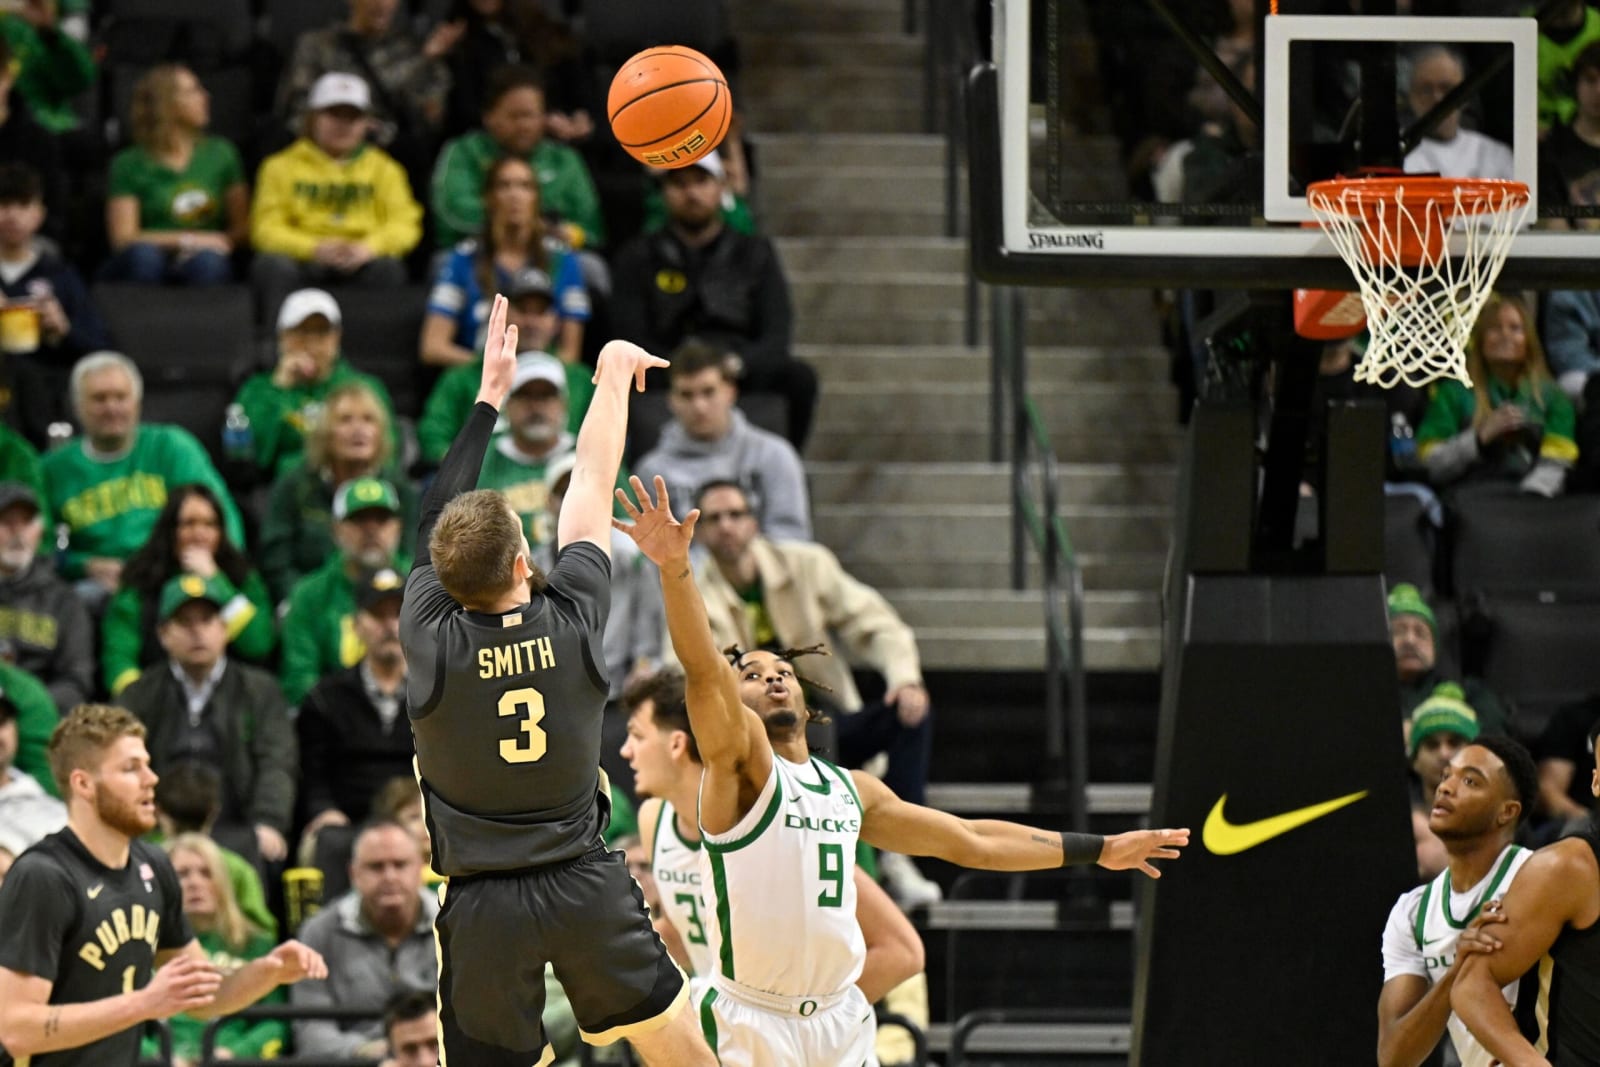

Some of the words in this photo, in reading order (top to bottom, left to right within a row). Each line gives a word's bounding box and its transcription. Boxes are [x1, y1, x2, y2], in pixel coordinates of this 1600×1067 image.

[645, 133, 707, 165] ELITE
[1028, 232, 1104, 250] SPALDING
[478, 636, 556, 679] SMITH
[497, 687, 547, 764] 3
[784, 814, 859, 833] DUCKS
[817, 843, 844, 908] 9
[674, 893, 709, 946] 3
[798, 1000, 818, 1017] O
